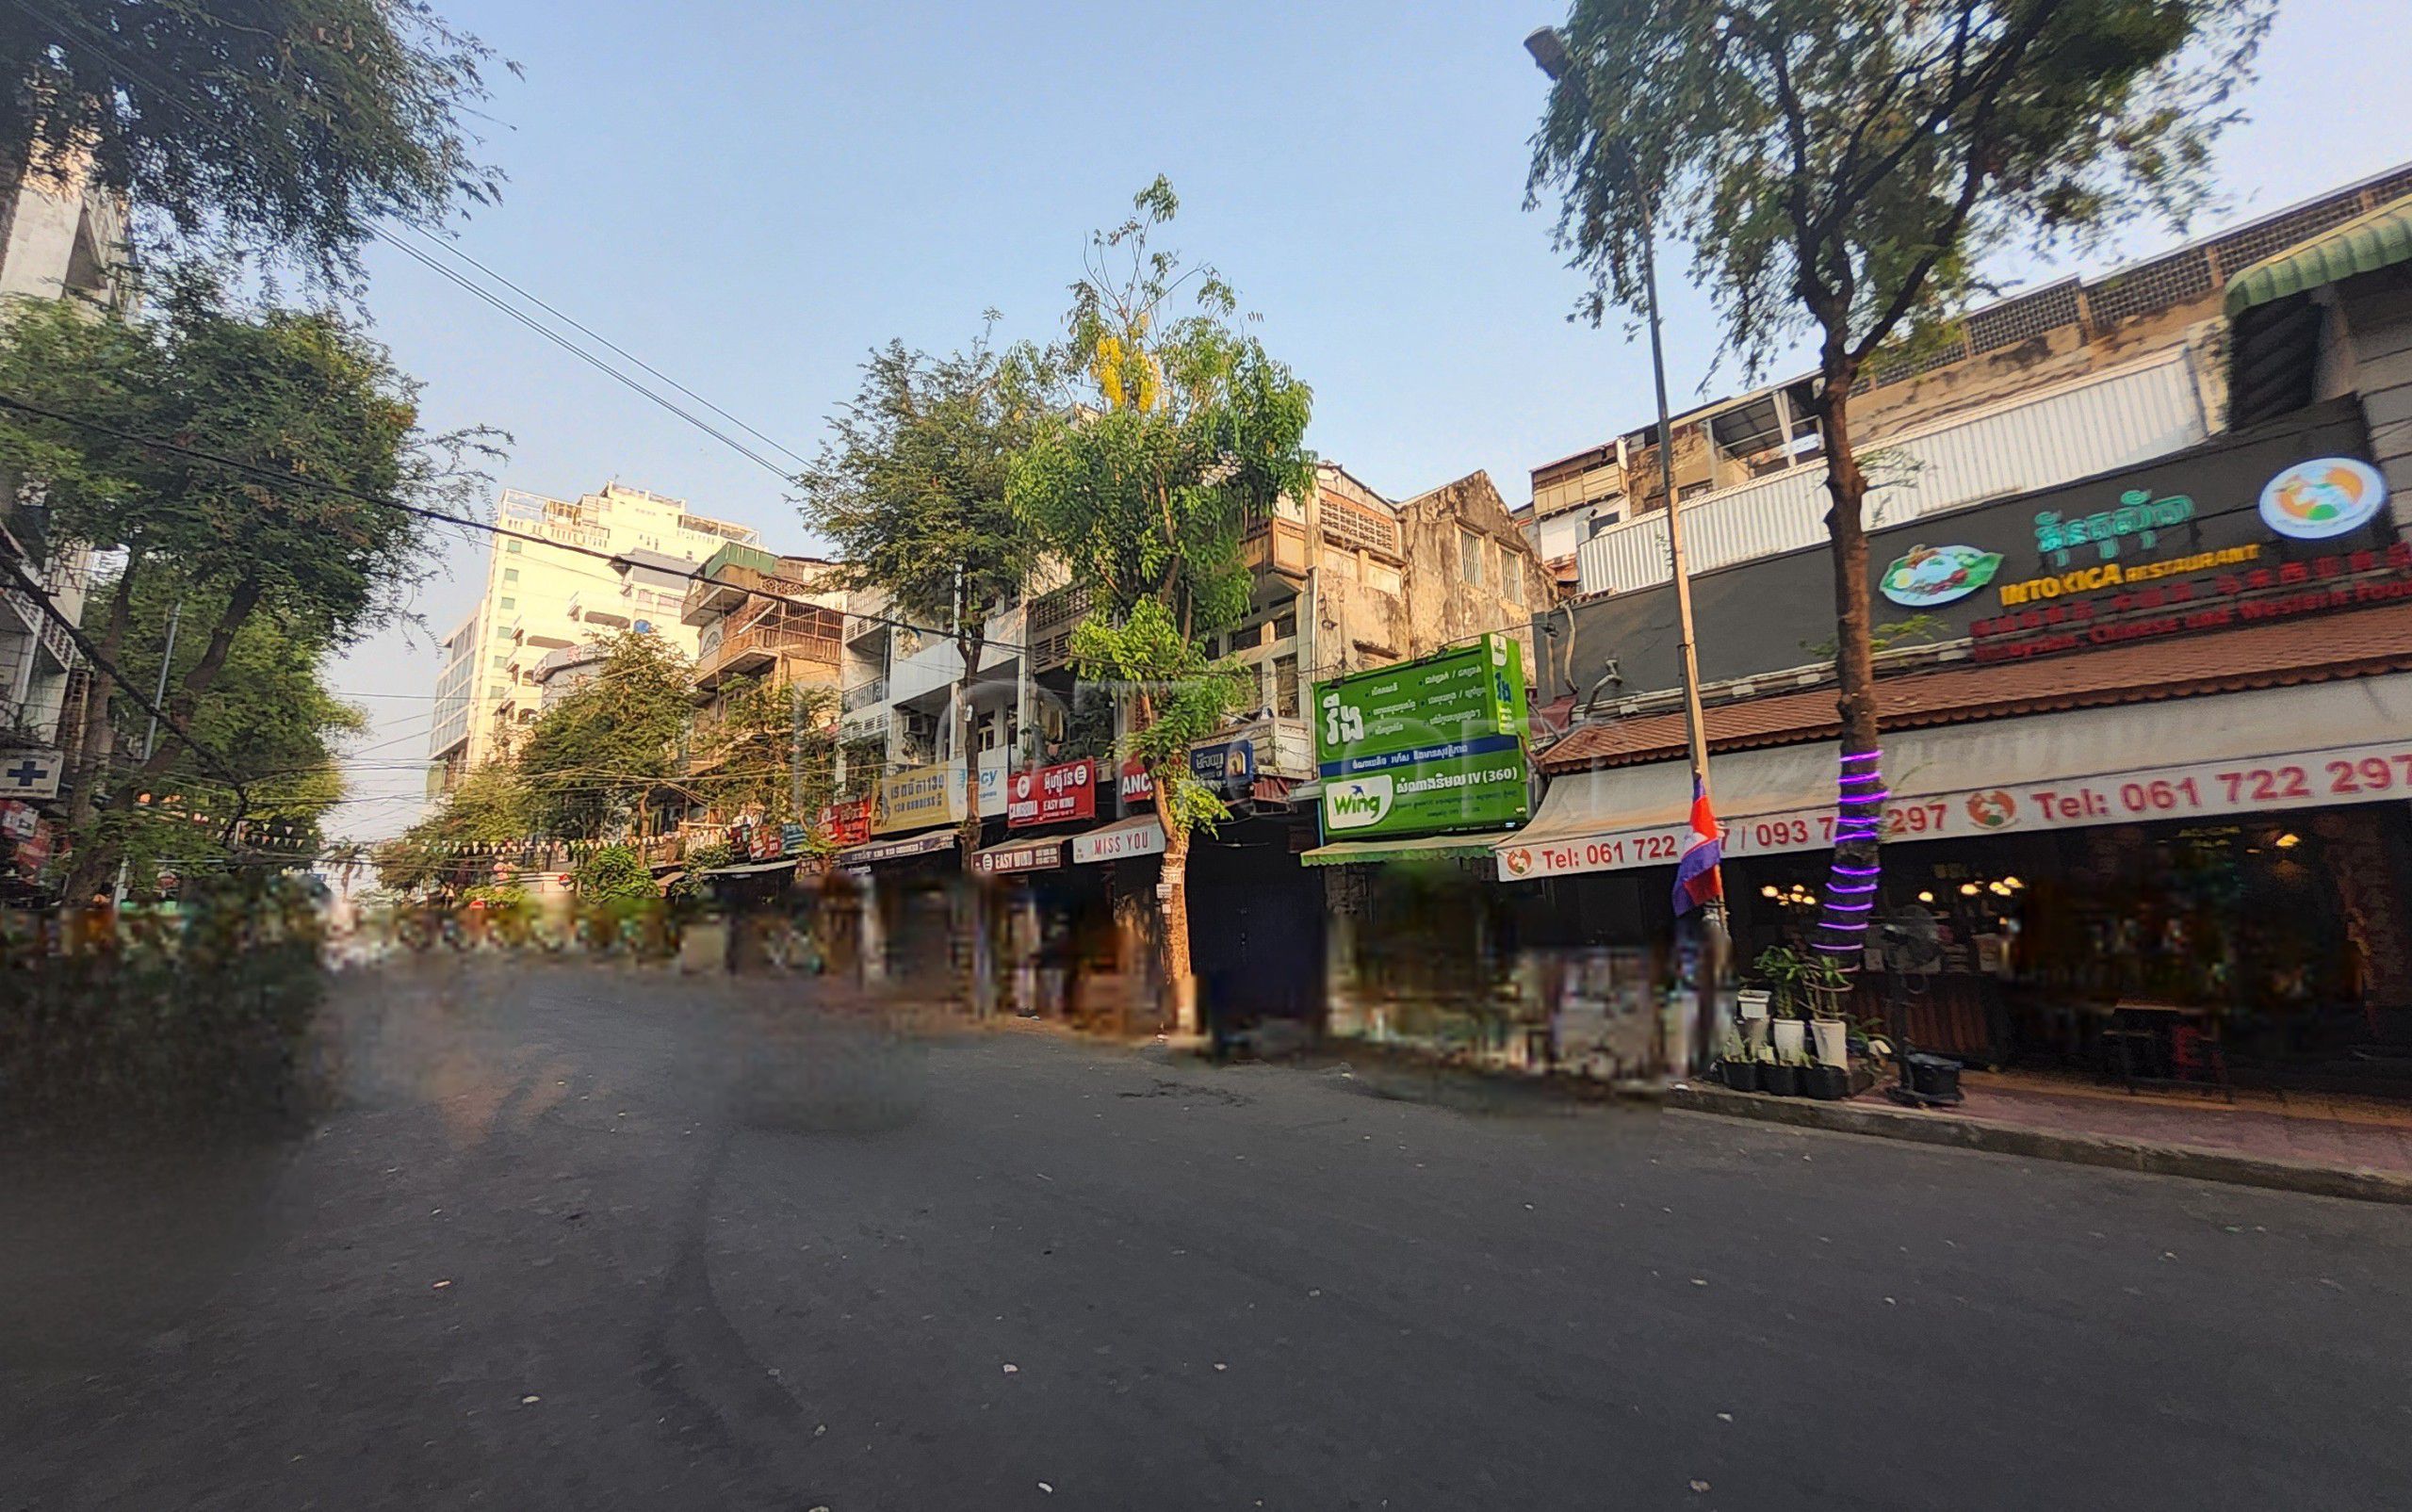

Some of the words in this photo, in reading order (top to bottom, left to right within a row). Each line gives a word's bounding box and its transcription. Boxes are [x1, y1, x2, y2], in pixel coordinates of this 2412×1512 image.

[2125, 544, 2261, 582] RESTAURANT
[1482, 767, 1518, 784] (360)
[1043, 799, 1059, 811] EASY
[2029, 789, 2110, 821] Tel:
[2121, 776, 2202, 812] 061
[2215, 766, 2313, 805] 722
[1334, 795, 1380, 820] Wing
[1094, 836, 1121, 855] MISS
[1125, 832, 1149, 850] YOU
[1542, 845, 1579, 870] Tel:
[1587, 840, 1624, 866] 061
[1633, 835, 1678, 860] 722
[1755, 820, 1809, 847] 093
[1886, 804, 1948, 835] 297
[995, 853, 1013, 870] EASY
